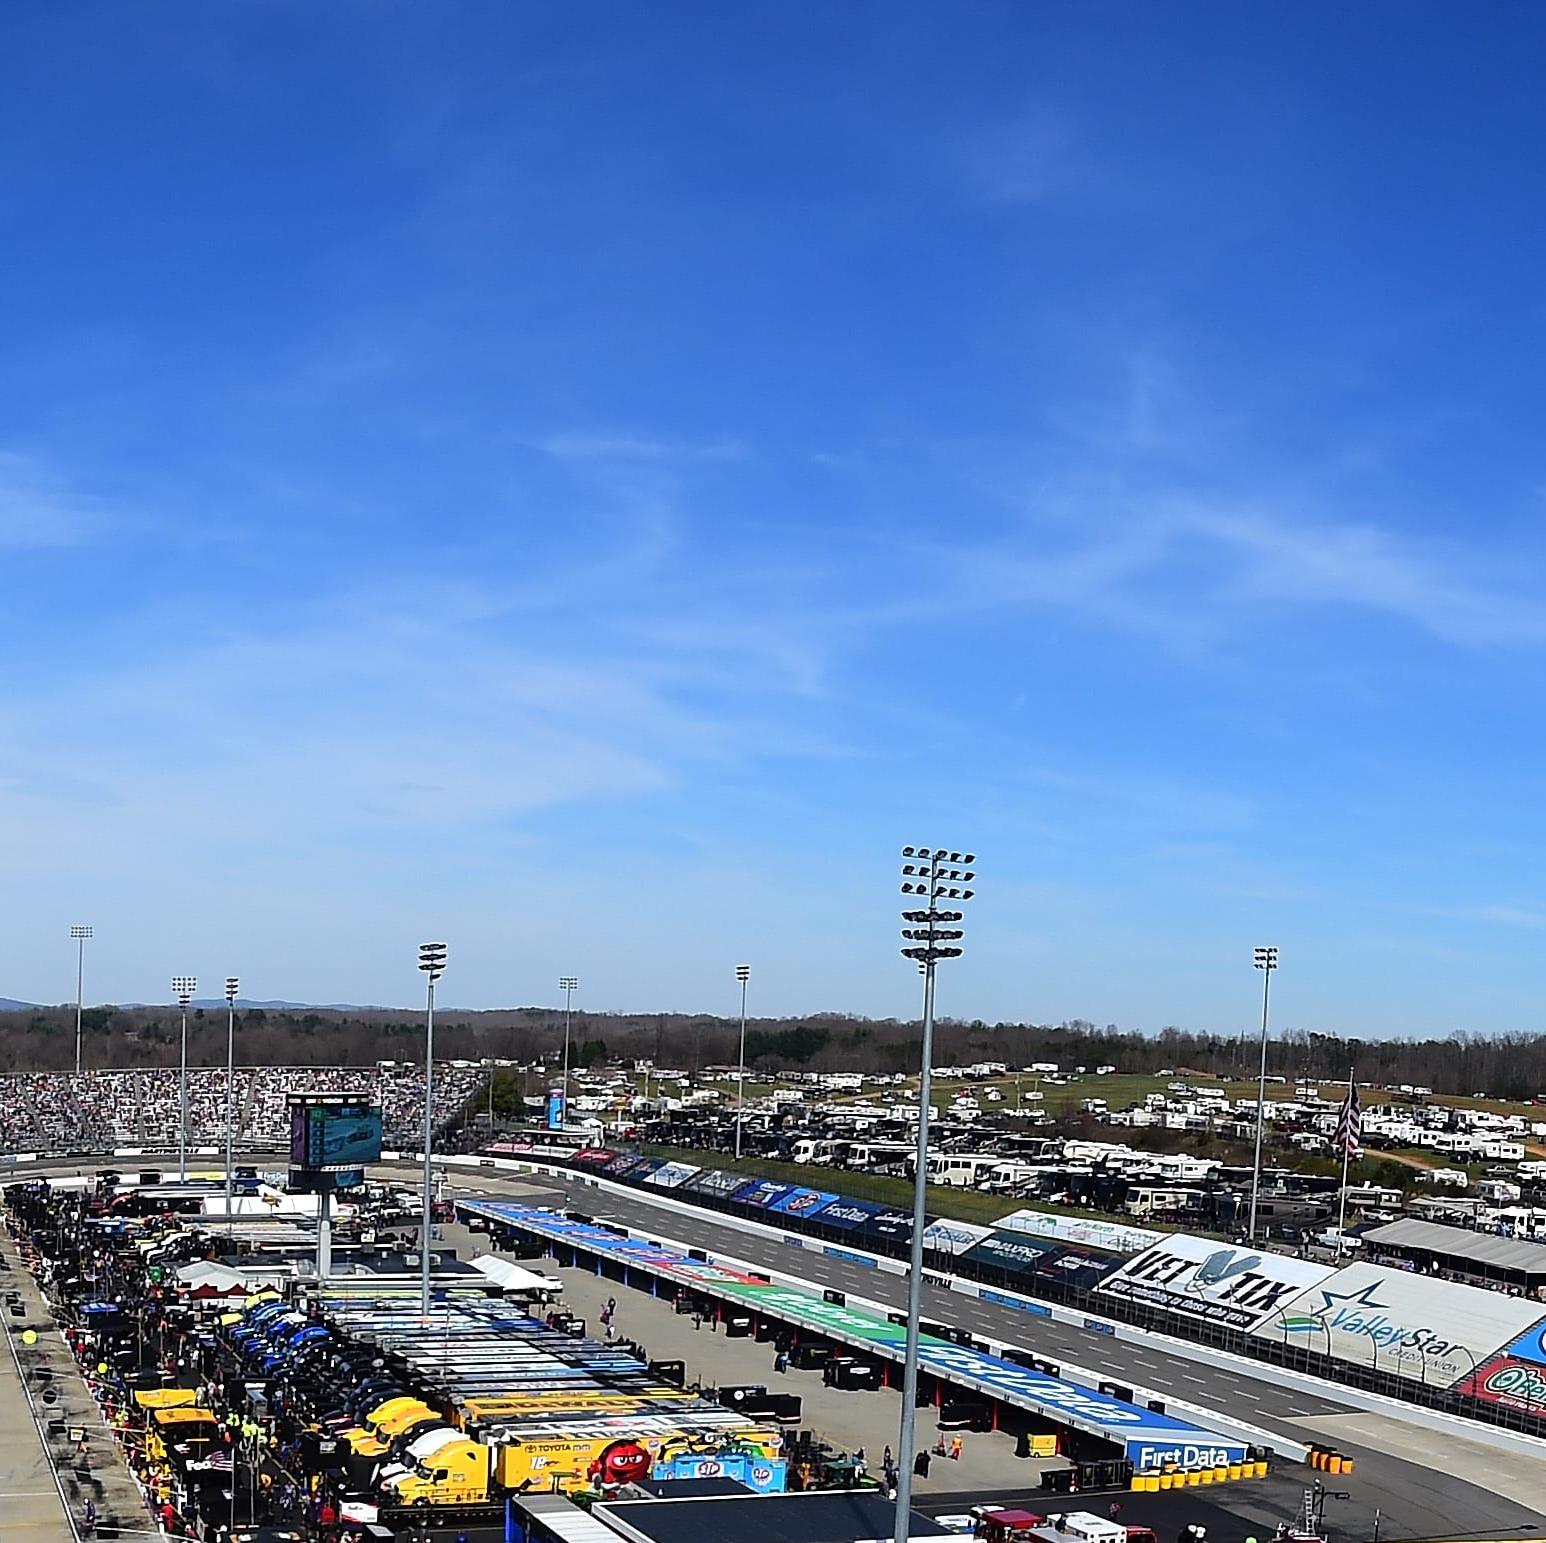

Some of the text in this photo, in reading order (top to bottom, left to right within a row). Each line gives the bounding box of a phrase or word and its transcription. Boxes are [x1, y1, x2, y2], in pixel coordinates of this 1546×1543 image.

[822, 1204, 847, 1219] First
[843, 1207, 871, 1223] Data
[1125, 1250, 1201, 1284] VET
[1218, 1271, 1300, 1311] TIX
[538, 1444, 571, 1452] TOYOTA
[1141, 1445, 1229, 1470] First Data
[530, 1456, 546, 1469] 18
